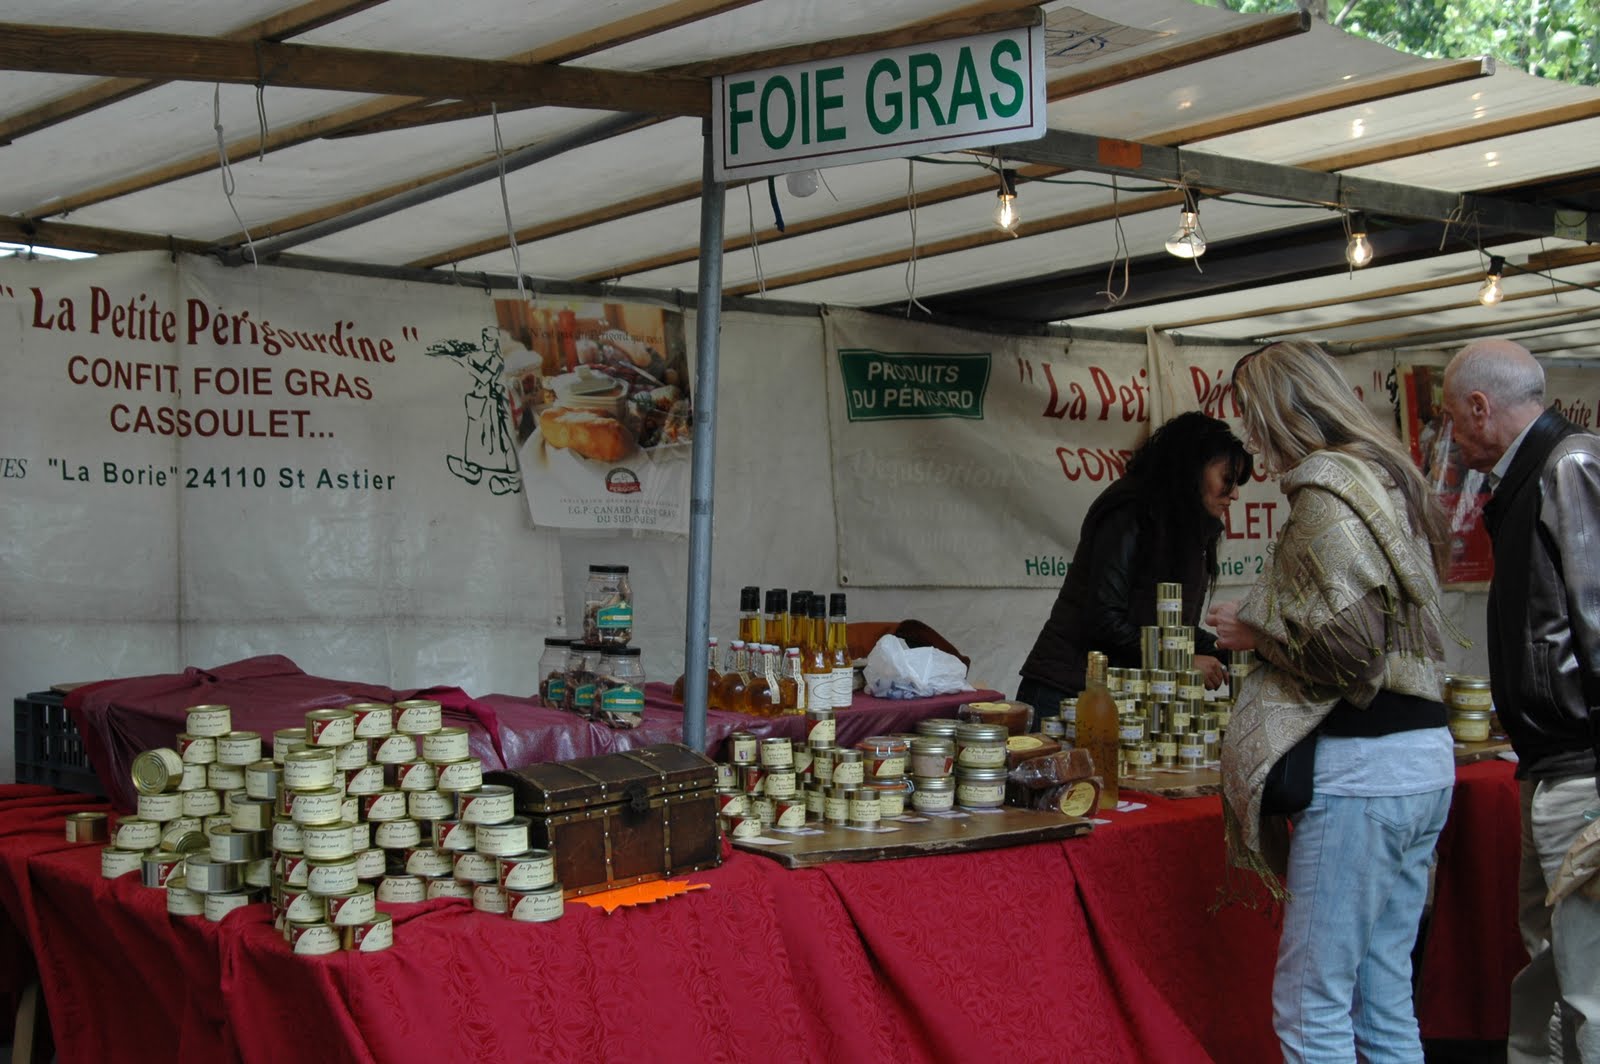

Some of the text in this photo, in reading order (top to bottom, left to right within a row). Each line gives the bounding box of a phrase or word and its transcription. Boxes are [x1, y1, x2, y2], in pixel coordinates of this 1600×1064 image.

[728, 38, 1025, 156] FOIE GRAS
[90, 286, 177, 344] Petite
[193, 367, 273, 396] FOIE
[284, 369, 373, 401] GRAS
[867, 361, 960, 383] PRODUITS
[852, 383, 974, 409] DU PÉRIGORD
[110, 403, 335, 439] CASSOULET...
[0, 457, 28, 479] ES
[185, 466, 266, 489] 24110
[279, 466, 306, 490] St
[316, 469, 396, 491] Astier
[593, 506, 632, 515] CANARD
[596, 514, 611, 524] DU
[1025, 555, 1073, 577] Hélé
